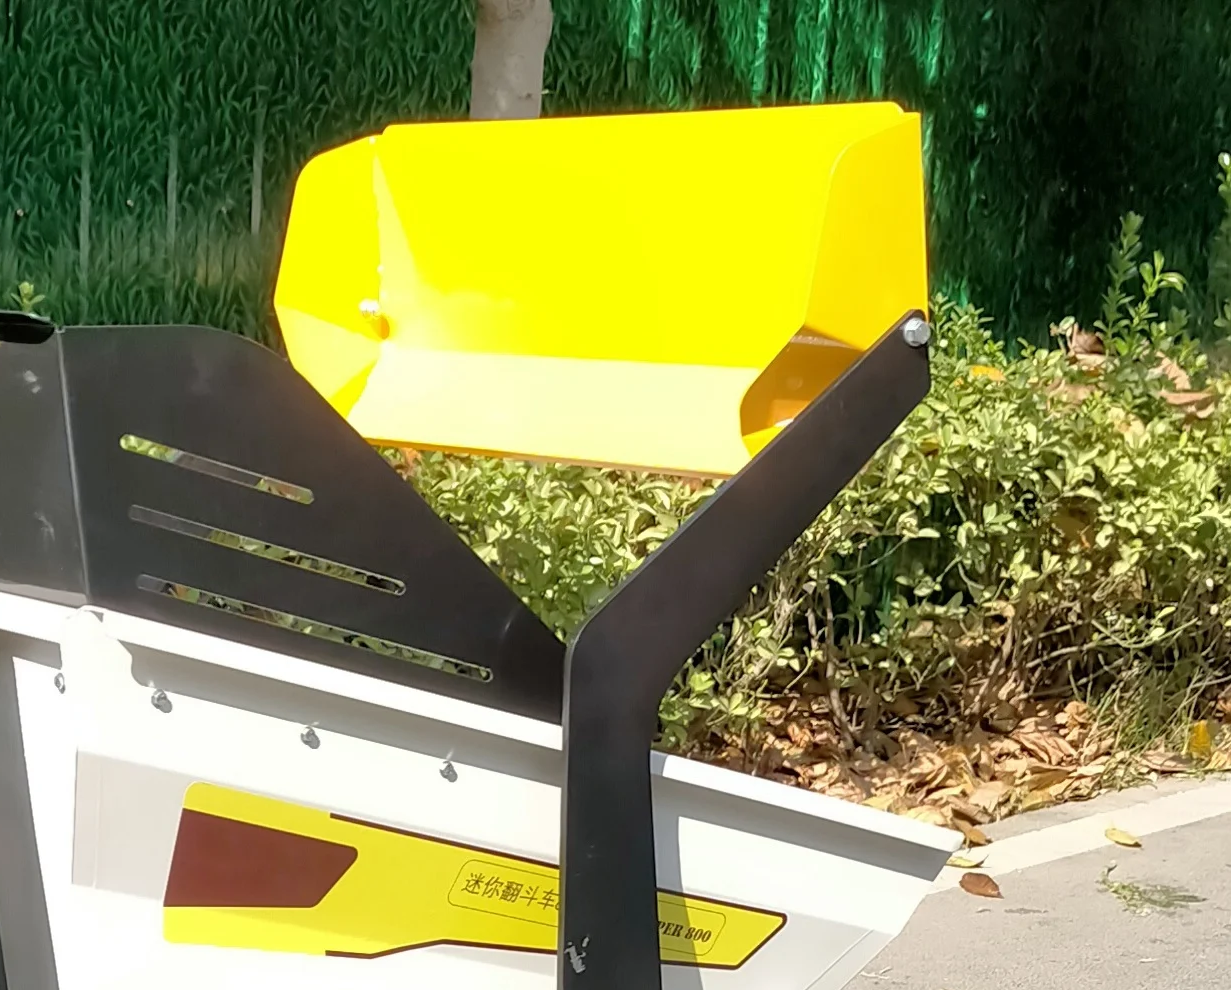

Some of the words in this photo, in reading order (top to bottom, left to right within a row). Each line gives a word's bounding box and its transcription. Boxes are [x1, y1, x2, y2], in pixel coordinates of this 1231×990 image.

[460, 872, 560, 911] 迷你翻斗车
[684, 926, 712, 943] 800
